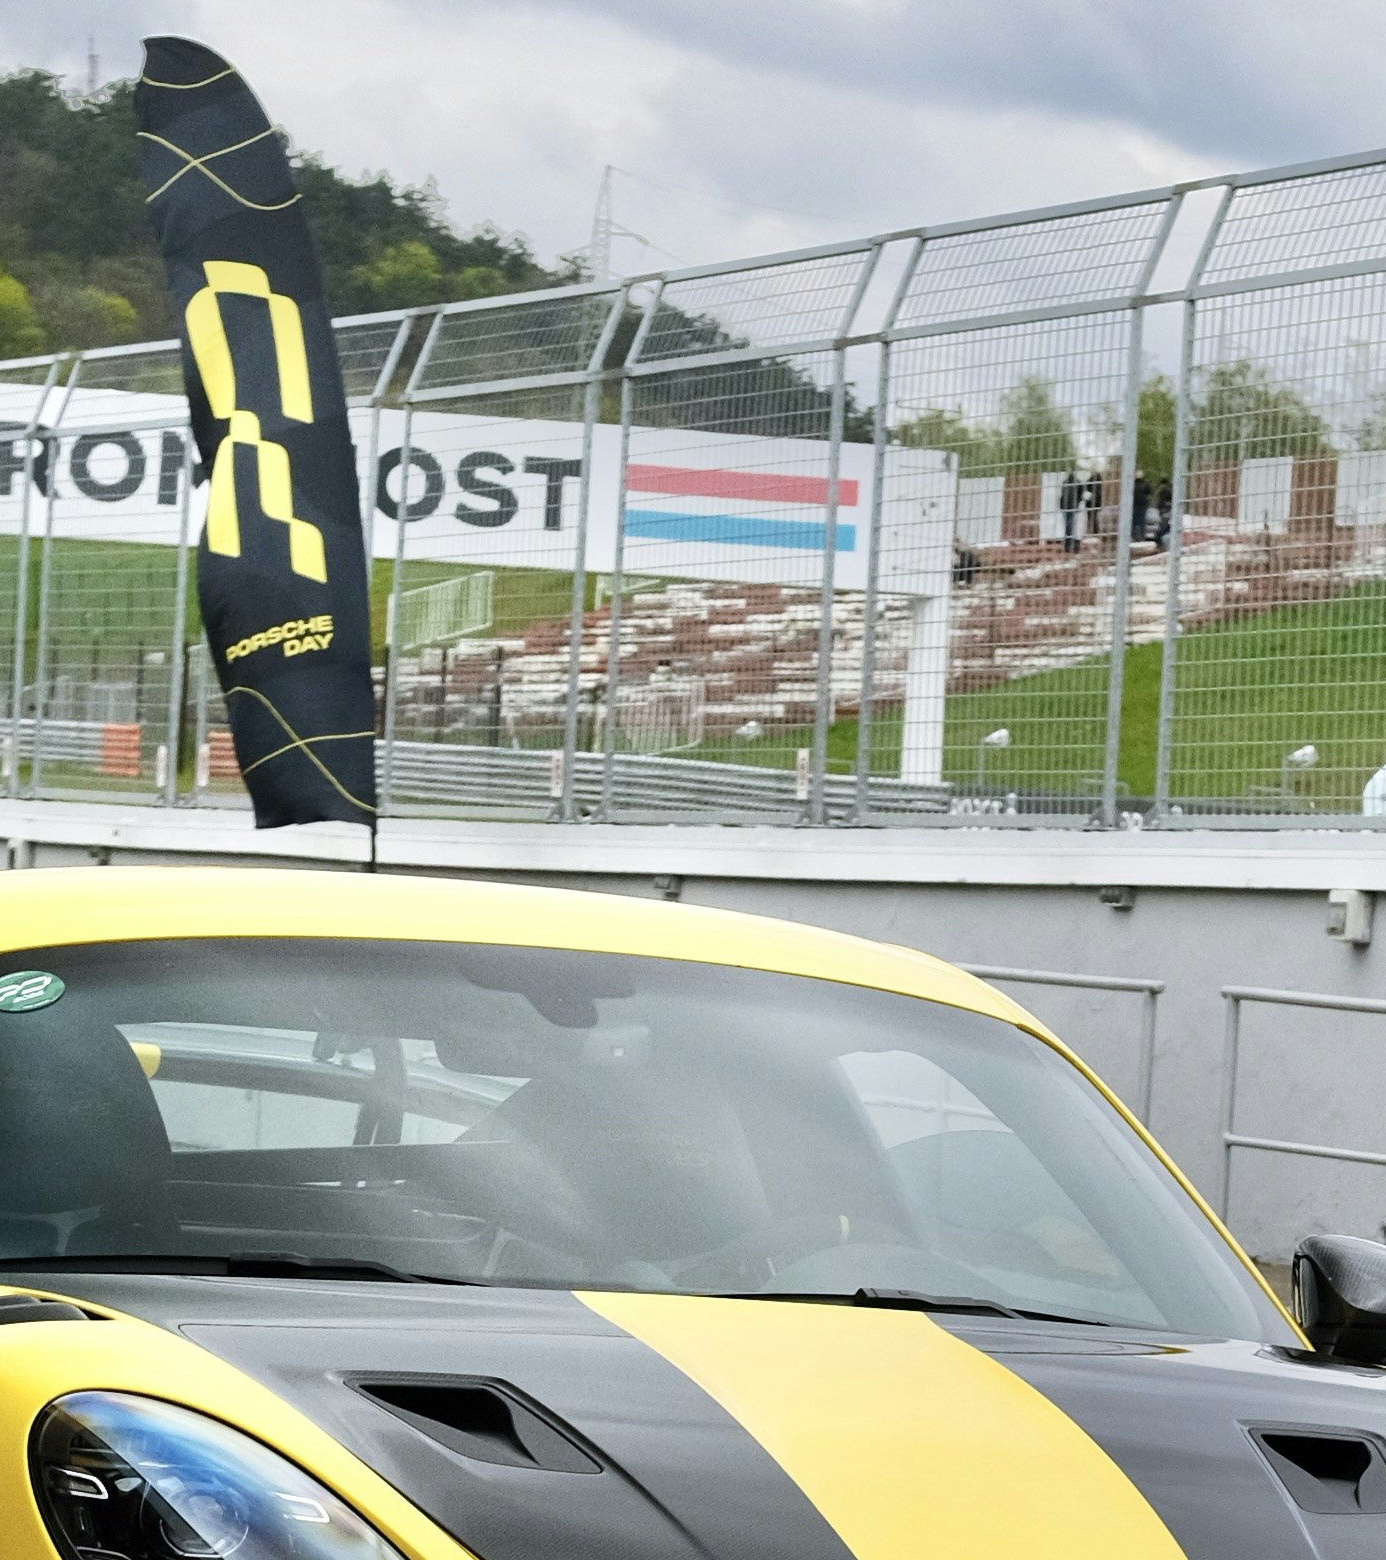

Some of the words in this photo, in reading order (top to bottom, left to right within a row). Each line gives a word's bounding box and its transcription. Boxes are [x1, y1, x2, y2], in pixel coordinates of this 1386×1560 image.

[376, 445, 584, 531] OST
[226, 615, 334, 664] PORSCHE
[283, 633, 334, 658] DAY
